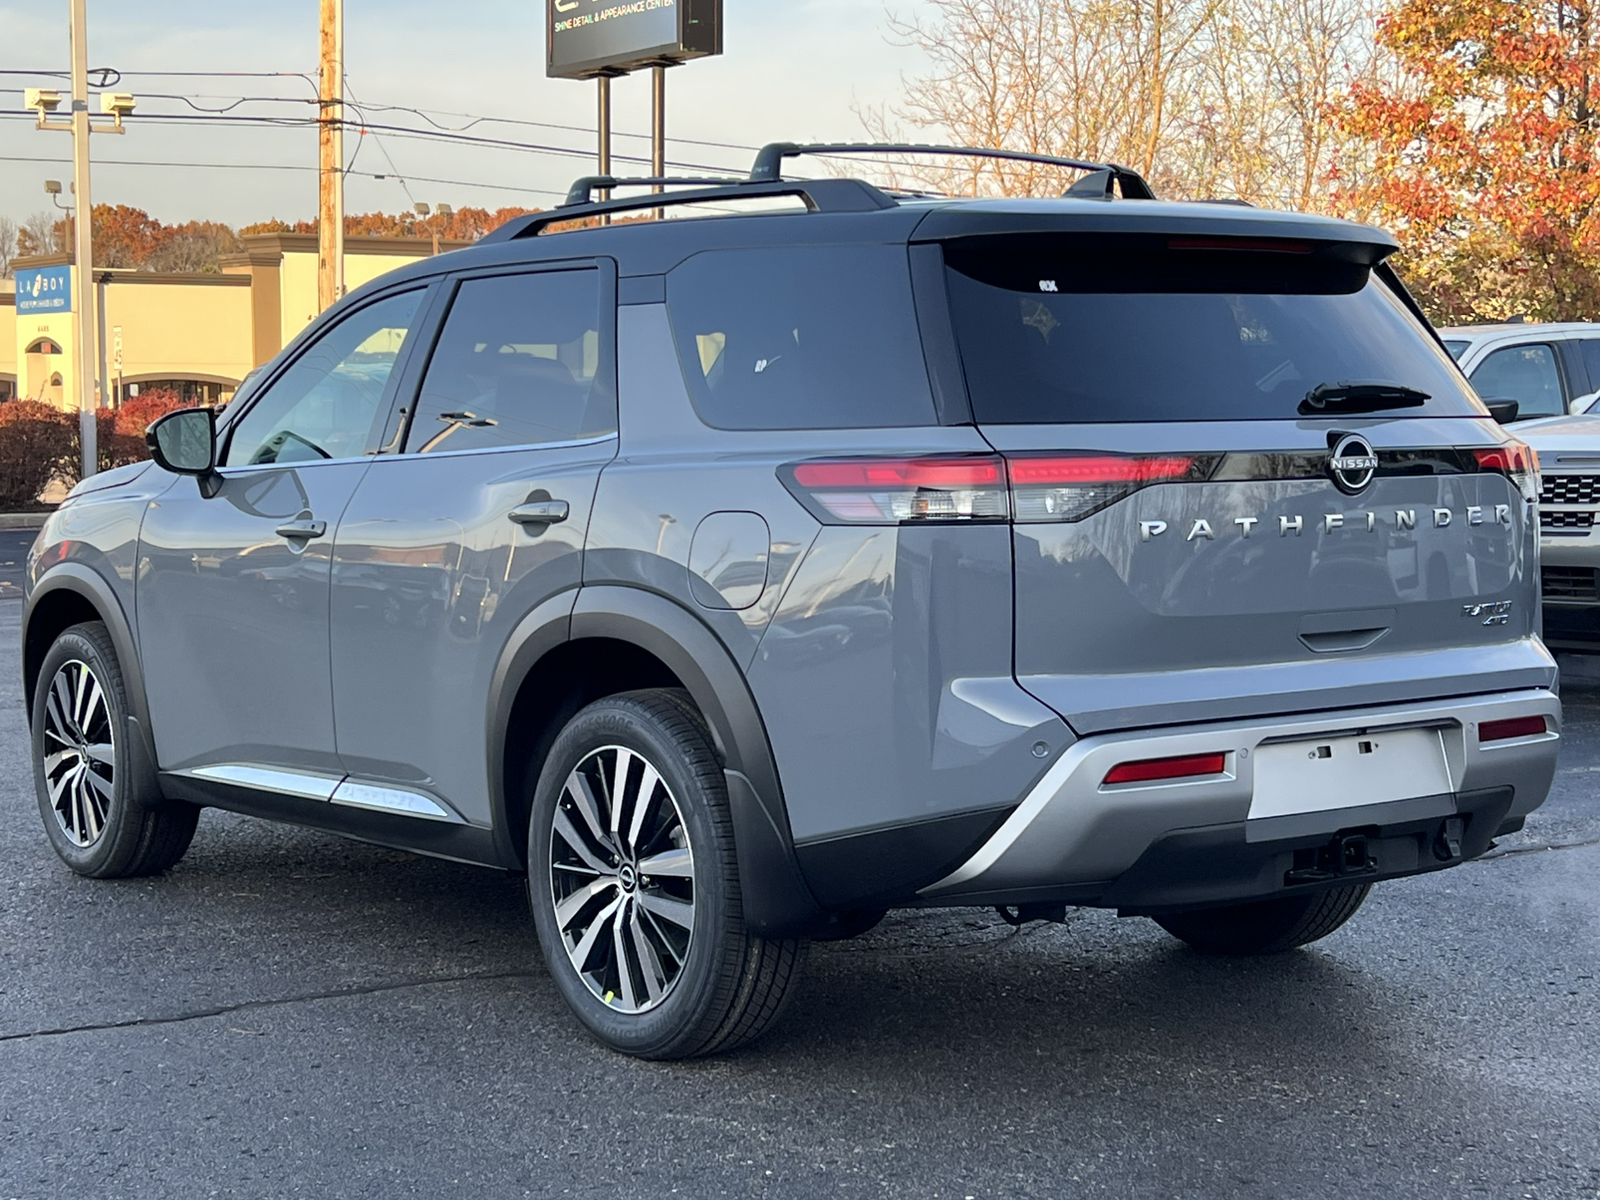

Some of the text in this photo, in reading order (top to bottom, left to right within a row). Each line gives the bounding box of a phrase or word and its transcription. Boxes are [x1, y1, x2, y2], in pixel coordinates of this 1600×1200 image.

[555, 19, 573, 32] SHINE
[573, 14, 594, 27] DETAIL
[600, 1, 645, 20] APPEARANCE
[1332, 458, 1378, 469] NISSAN
[1139, 504, 1510, 543] PATHFINDER
